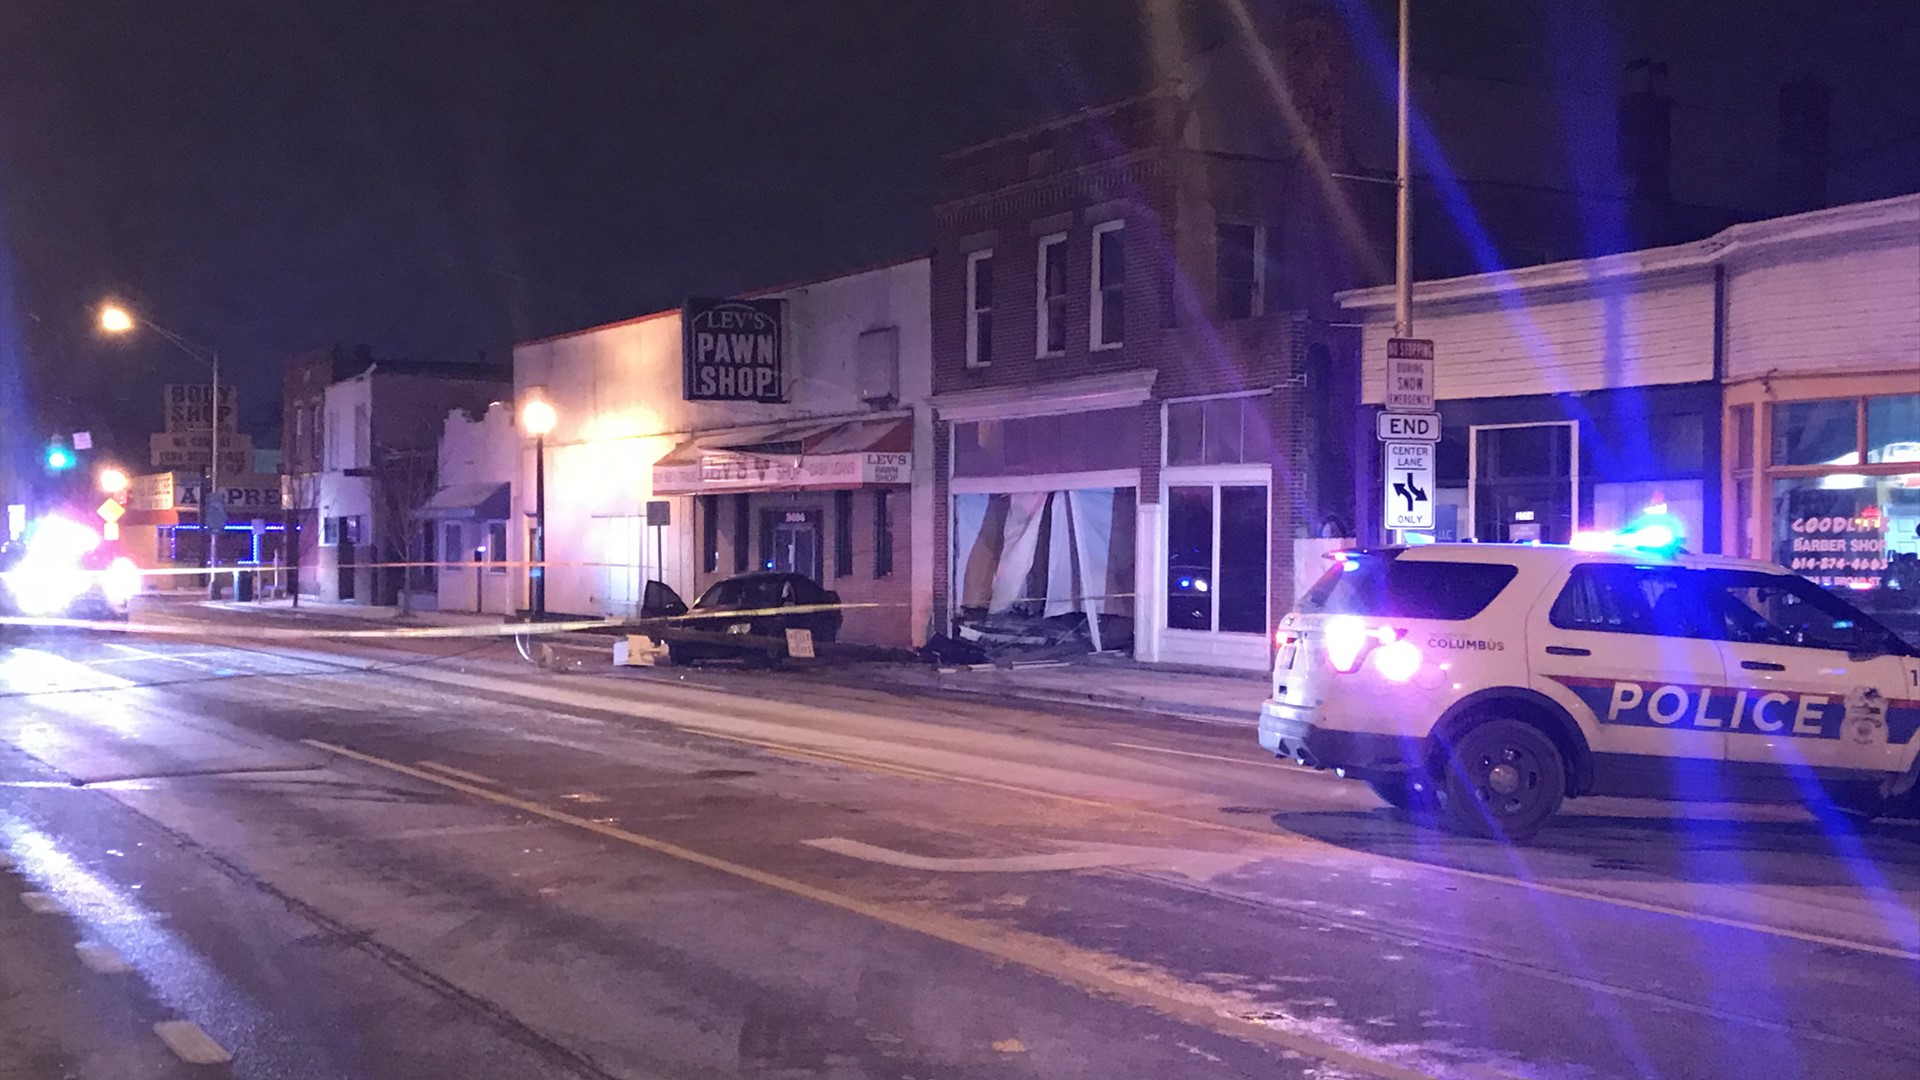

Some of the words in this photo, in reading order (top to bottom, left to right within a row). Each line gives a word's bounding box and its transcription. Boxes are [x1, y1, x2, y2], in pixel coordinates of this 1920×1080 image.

[707, 311, 767, 330] LEV'S
[698, 332, 773, 364] PAWN
[701, 366, 773, 396] SHOP
[1397, 377, 1423, 390] SNOW
[1389, 393, 1431, 405] EMERGENCY
[1390, 419, 1429, 434] END
[1392, 447, 1428, 456] CENTER
[867, 454, 907, 465] LEV'S
[1398, 458, 1423, 466] LANE
[875, 465, 899, 474] PAWN
[875, 474, 899, 482] SHOP
[1397, 515, 1423, 524] ONLY
[1793, 538, 1846, 552] BARBER
[1850, 539, 1887, 552] SHOP
[1428, 639, 1505, 651] COLUMBUS
[1608, 682, 1829, 735] POLICE
